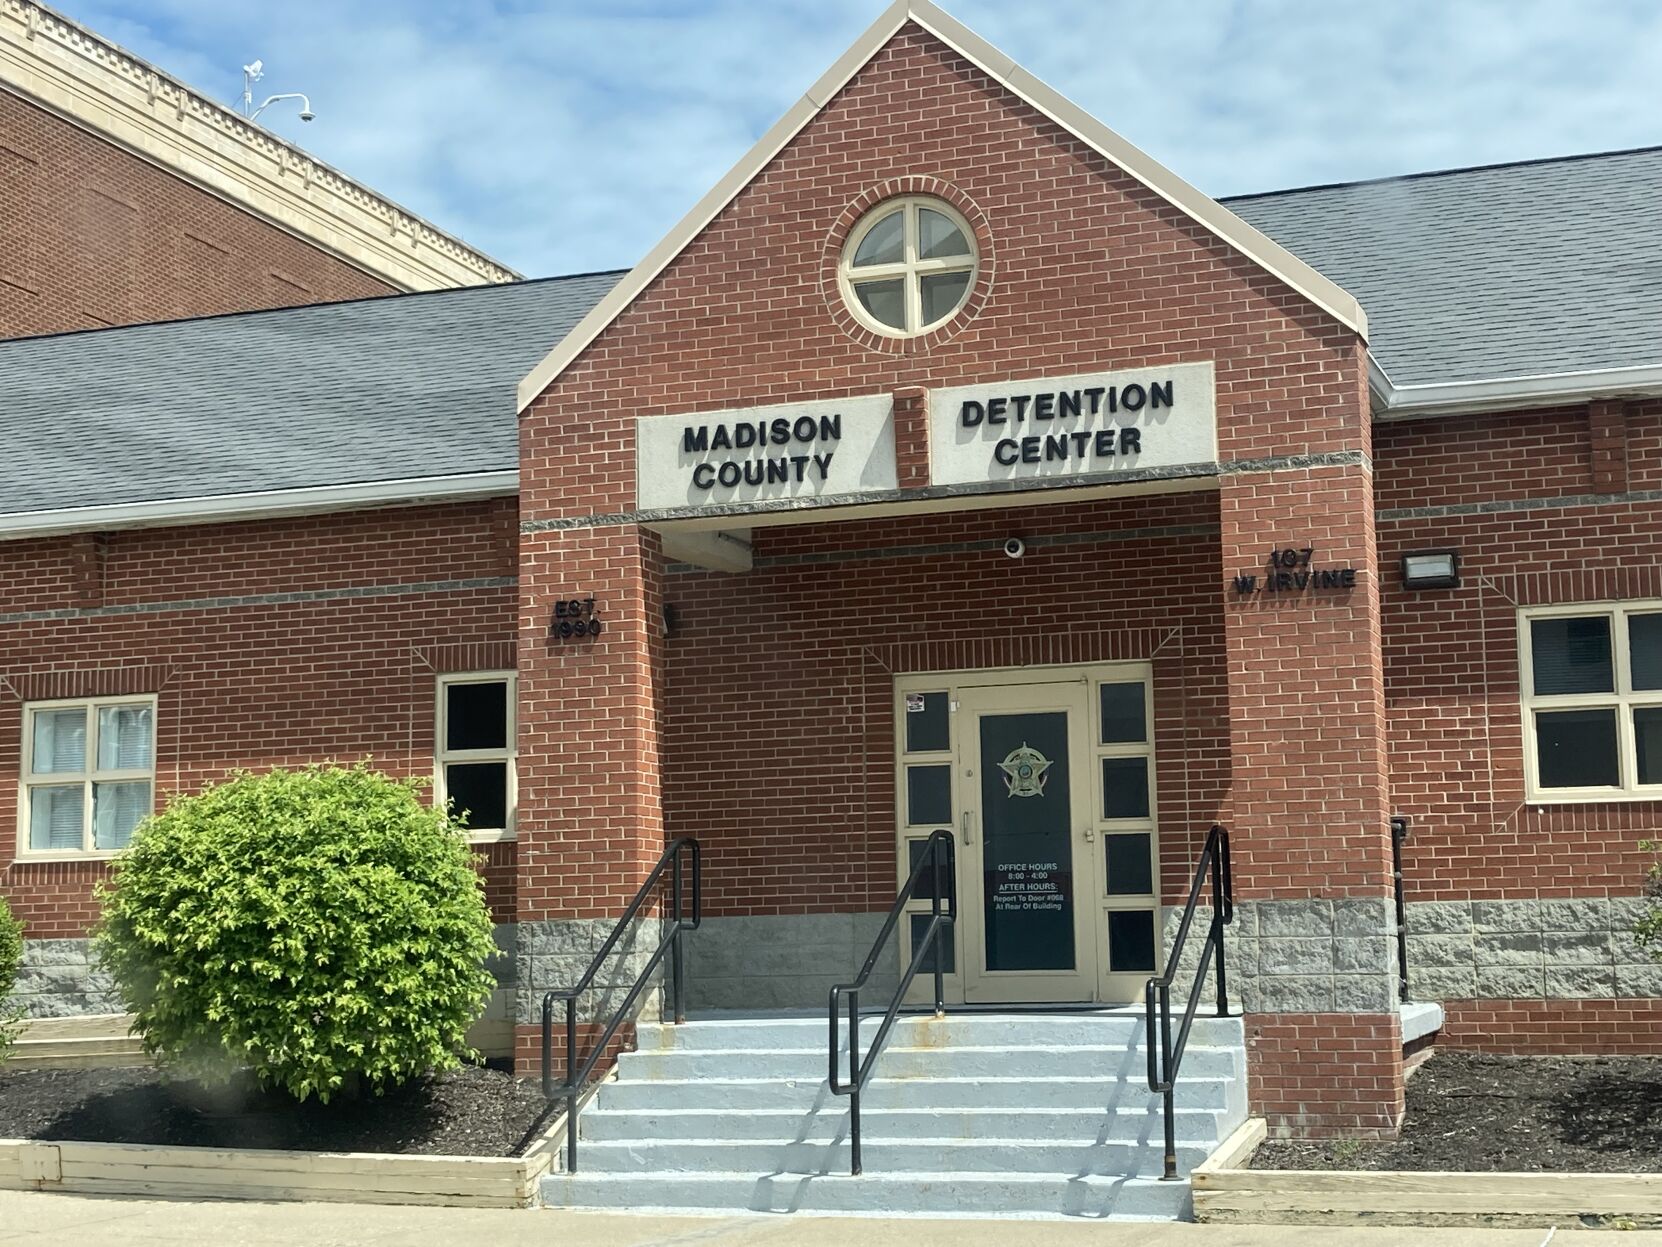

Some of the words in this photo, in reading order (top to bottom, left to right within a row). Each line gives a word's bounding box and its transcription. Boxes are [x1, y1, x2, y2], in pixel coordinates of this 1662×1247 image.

[962, 380, 1174, 427] DETENTION
[684, 414, 842, 453] MADISON
[994, 427, 1142, 466] CENTER
[693, 452, 834, 490] COUNTY
[1271, 548, 1314, 568] 107
[1267, 569, 1357, 592] IRVINE
[998, 863, 1027, 872] OFFICE
[1028, 862, 1058, 871] HOURS
[999, 883, 1026, 891] AFTER
[993, 895, 1017, 903] Report
[1028, 894, 1045, 902] Door
[1005, 902, 1021, 910] Rear
[1022, 902, 1032, 910] Of
[1032, 902, 1062, 911] Building
